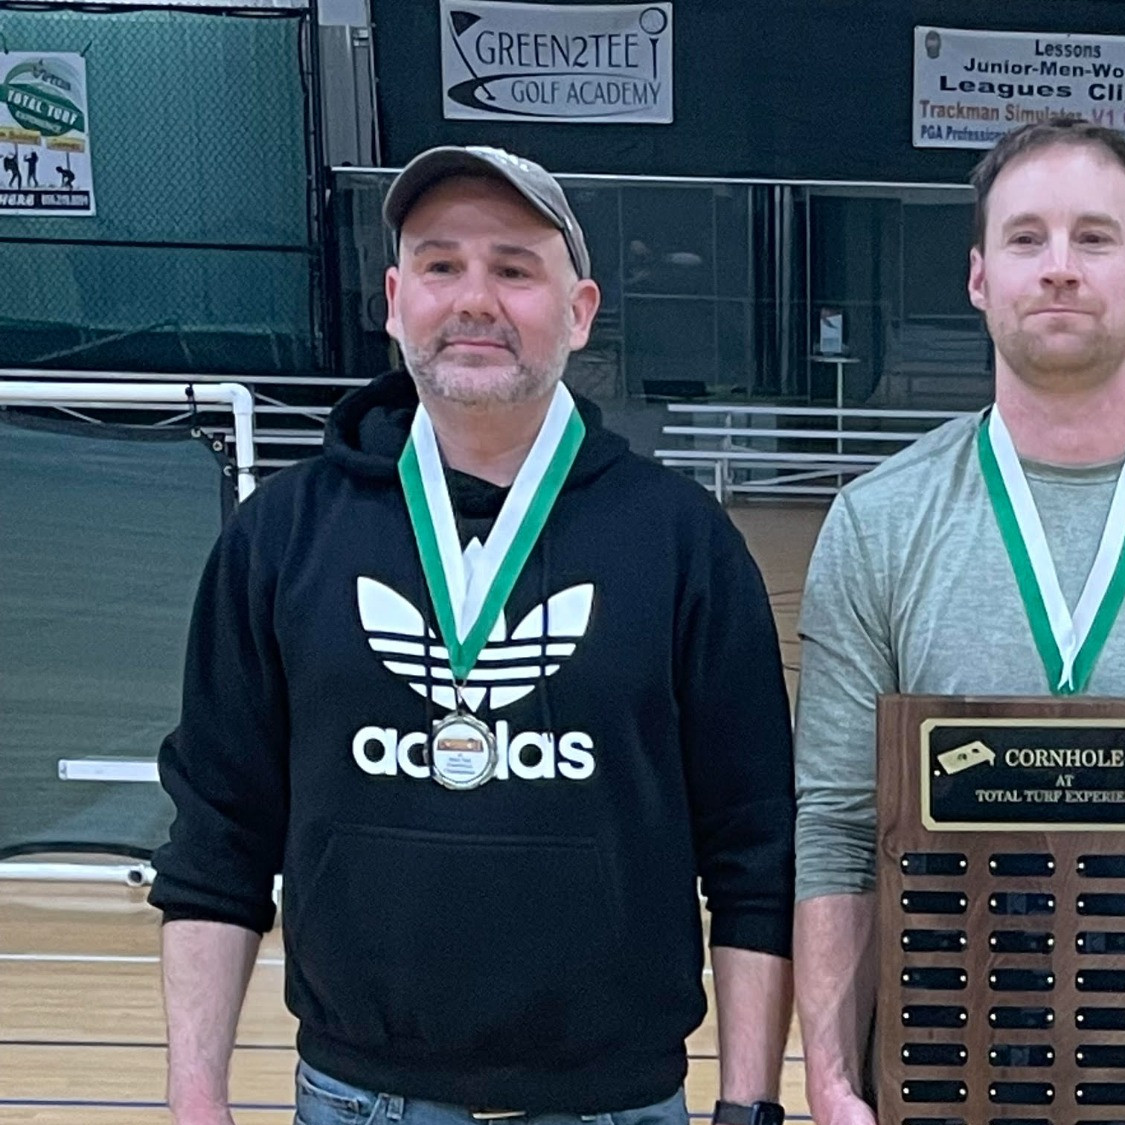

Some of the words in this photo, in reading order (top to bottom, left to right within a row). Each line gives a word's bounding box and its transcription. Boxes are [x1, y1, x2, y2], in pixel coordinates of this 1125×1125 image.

[475, 30, 639, 68] GREEN2TEE
[1035, 39, 1101, 58] Lessons
[511, 80, 560, 104] GOLF
[566, 81, 661, 105] ACADEMY
[940, 76, 1072, 98] Leagues
[7, 90, 42, 113] TOTAL
[920, 100, 999, 121] Trackman
[1092, 109, 1113, 126] V1
[921, 125, 942, 139] PGA
[352, 719, 597, 781] adas
[1005, 749, 1125, 767] CORNHOLE
[1055, 774, 1074, 787] AT
[975, 790, 1022, 802] TOTAL
[1024, 790, 1062, 802] TURF
